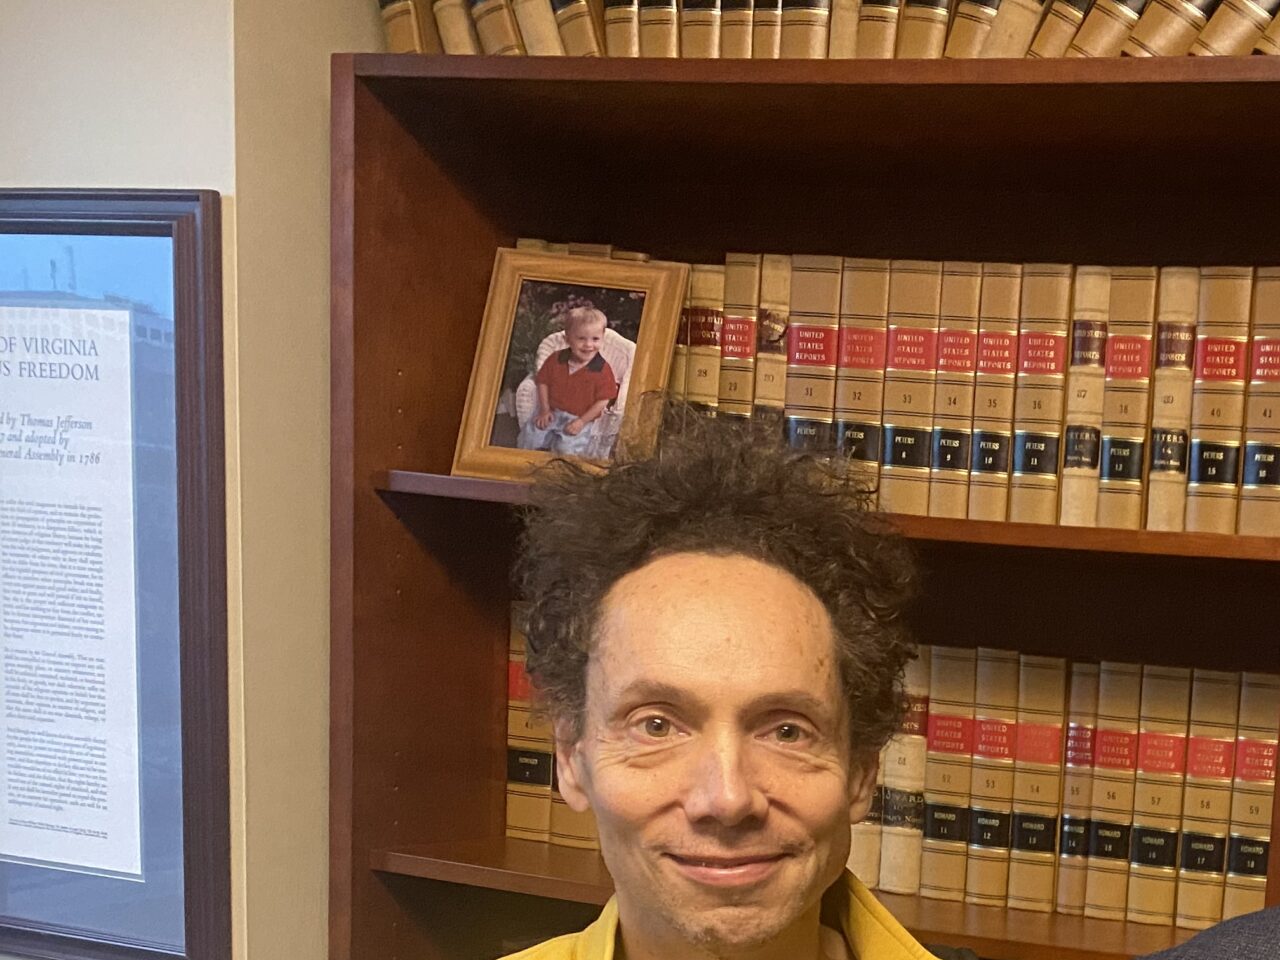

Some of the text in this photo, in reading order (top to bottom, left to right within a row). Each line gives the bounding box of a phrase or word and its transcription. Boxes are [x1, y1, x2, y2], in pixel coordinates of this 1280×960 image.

[799, 331, 825, 339] UNITED
[944, 336, 970, 344] UNITED
[983, 338, 1009, 346] UNITED
[1028, 338, 1055, 346] UNITED
[22, 337, 98, 356] VIRGINIA
[799, 342, 824, 350] STATES
[897, 346, 924, 354] STATES
[1114, 342, 1141, 350] UNITED
[1208, 344, 1235, 352] UNITED
[943, 348, 969, 356] STATES
[795, 353, 825, 361] REPORTS
[939, 359, 971, 367] REPORTS
[979, 361, 1011, 369] REPORTS
[1023, 361, 1056, 370] REPORTS
[0, 360, 100, 380] S FREEDOM
[1110, 365, 1142, 374] REPORTS
[1203, 368, 1237, 376] REPORTS
[853, 392, 862, 401] 32
[903, 395, 912, 404] 33
[948, 397, 957, 406] 34
[988, 399, 997, 408] 35
[1033, 401, 1042, 410] 36
[1211, 409, 1221, 417] 40
[1263, 409, 1272, 418] 41
[6, 412, 92, 432] by Thomas Jefferson
[7, 430, 69, 449] and adopted by
[845, 431, 865, 439] PETERS
[895, 436, 915, 444] PETERS
[940, 439, 960, 447] PETERS
[980, 442, 999, 450] PETERS
[1026, 442, 1045, 451] PETERS
[1110, 448, 1130, 456] PETERS
[1203, 452, 1224, 460] PETERS
[24, 448, 64, 466] Assembly
[80, 452, 100, 466] 1786
[1255, 453, 1274, 462] PETERS
[981, 723, 1007, 733] UNITED
[981, 735, 1007, 743] STATES
[1102, 736, 1129, 745] UNITED
[977, 744, 1009, 754] REPORTS
[1107, 791, 1117, 800] 56
[1151, 797, 1161, 806] 57
[1200, 800, 1210, 809] 58
[1249, 805, 1260, 815] 59
